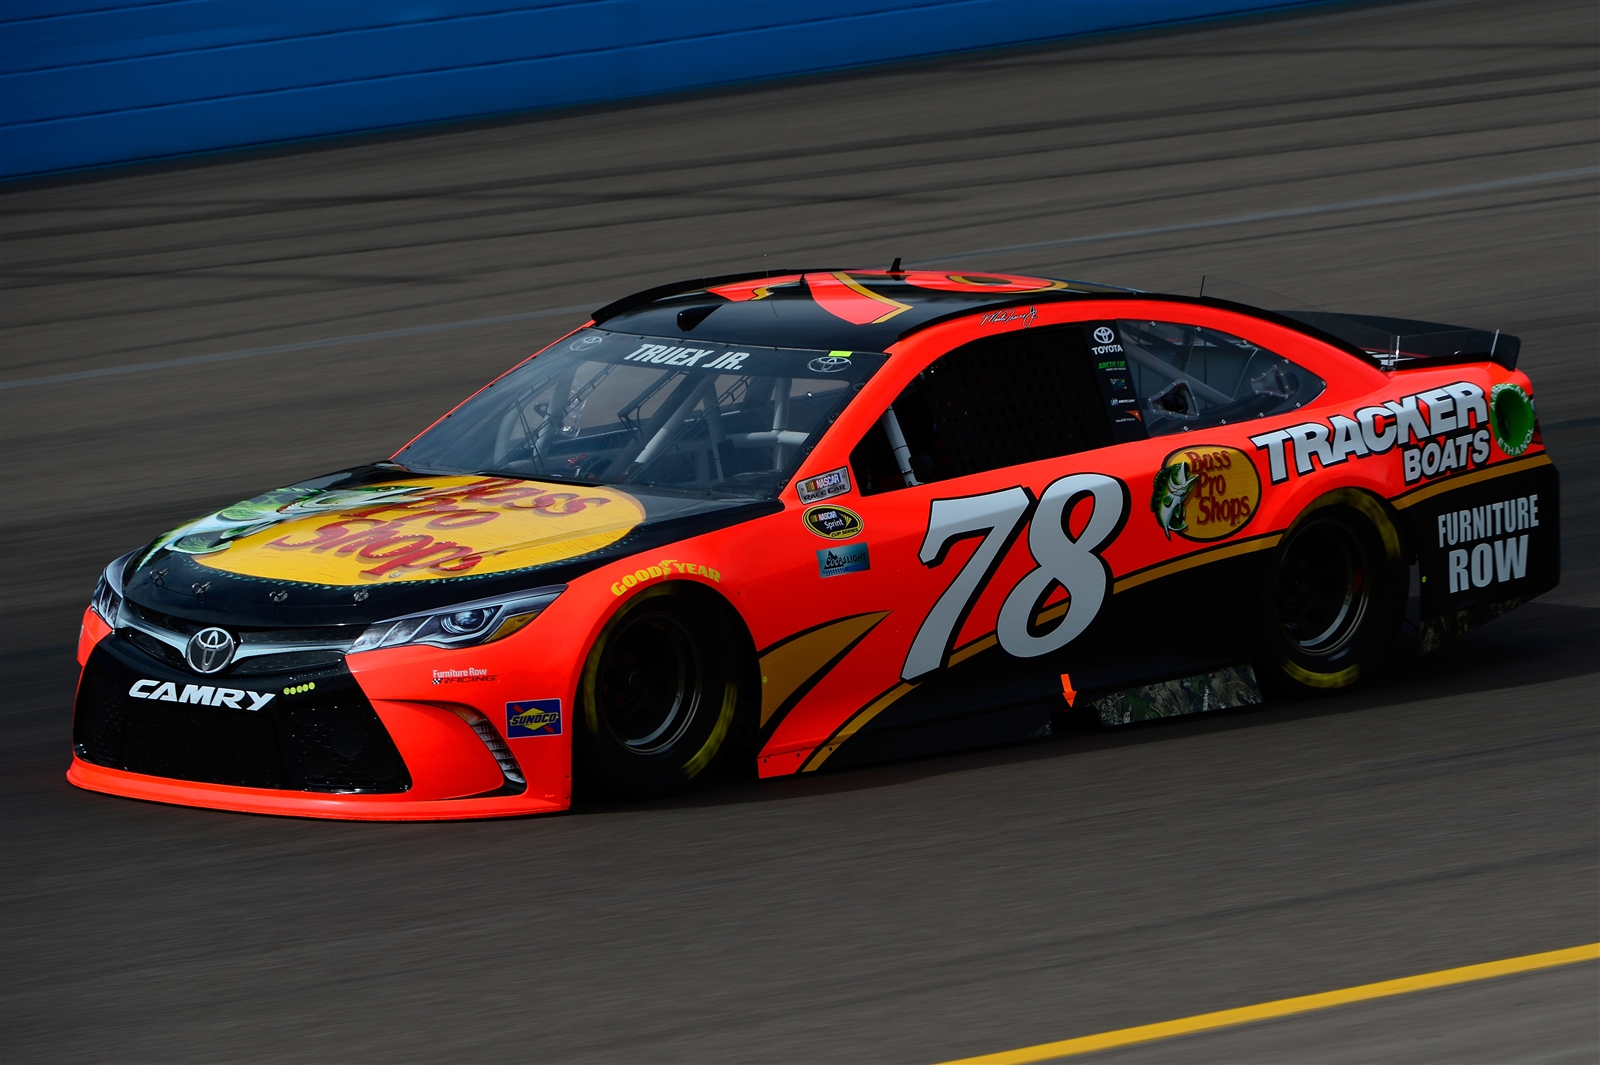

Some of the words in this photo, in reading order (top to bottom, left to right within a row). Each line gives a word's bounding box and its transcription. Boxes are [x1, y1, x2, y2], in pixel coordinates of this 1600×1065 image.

[623, 343, 704, 367] TRUEX
[702, 351, 750, 370] JR.
[1091, 344, 1124, 355] TOYOTA
[1098, 361, 1117, 370] ARCTIC
[1250, 381, 1489, 484] TRACKER
[1497, 428, 1535, 456] ETHANOL
[1184, 450, 1231, 473] Bass
[1403, 429, 1490, 483] BOATS
[803, 489, 828, 501] RACE
[828, 484, 847, 494] CAR
[816, 474, 841, 489] NASCAR
[1194, 472, 1226, 498] Pro
[339, 497, 501, 529] Pro
[818, 511, 838, 521] NASCAR
[1196, 496, 1251, 526] Shops
[1437, 494, 1540, 548] FURNITURE
[824, 519, 845, 531] Sprint
[842, 528, 859, 536] SERIES
[264, 519, 483, 577] Shops
[846, 552, 867, 564] LIGHT
[1448, 534, 1530, 594] ROW
[901, 472, 1125, 681] 78
[433, 669, 468, 678] Furniture
[469, 668, 488, 676] Row
[439, 675, 498, 684] RACING
[128, 679, 276, 711] CAMRY
[511, 712, 558, 726] SUNOCO
